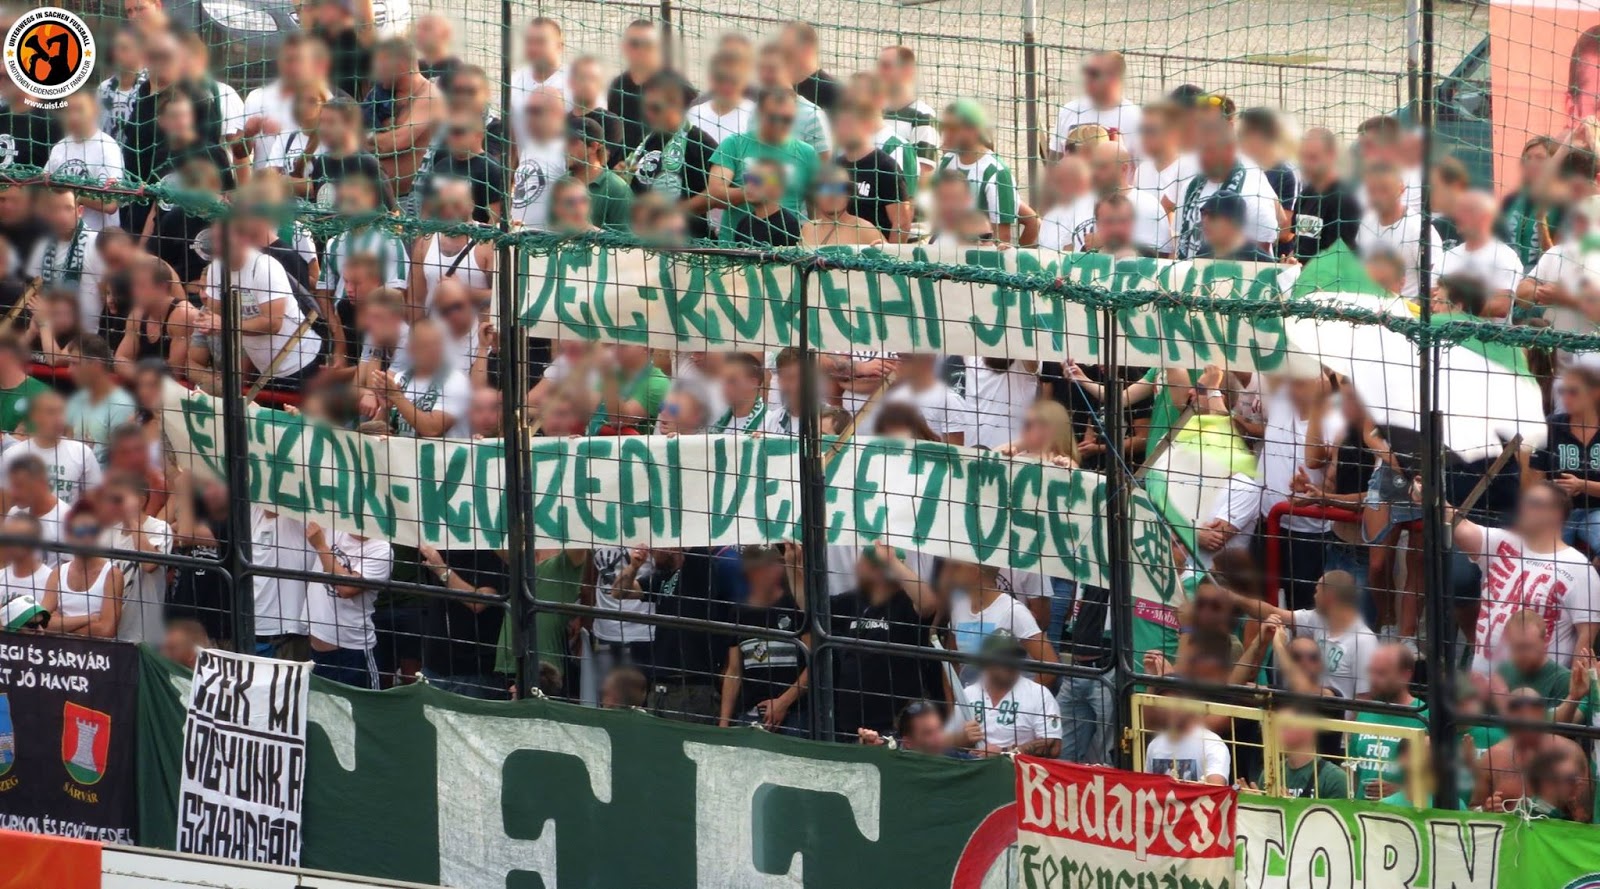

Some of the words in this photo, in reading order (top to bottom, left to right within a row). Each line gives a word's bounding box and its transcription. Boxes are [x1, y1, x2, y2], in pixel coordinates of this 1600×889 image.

[27, 644, 44, 665] ÉS
[47, 648, 111, 672] SÁRVÁRI
[17, 668, 36, 688] JÓ
[40, 673, 89, 693] HAVER
[43, 814, 58, 835] ÉS
